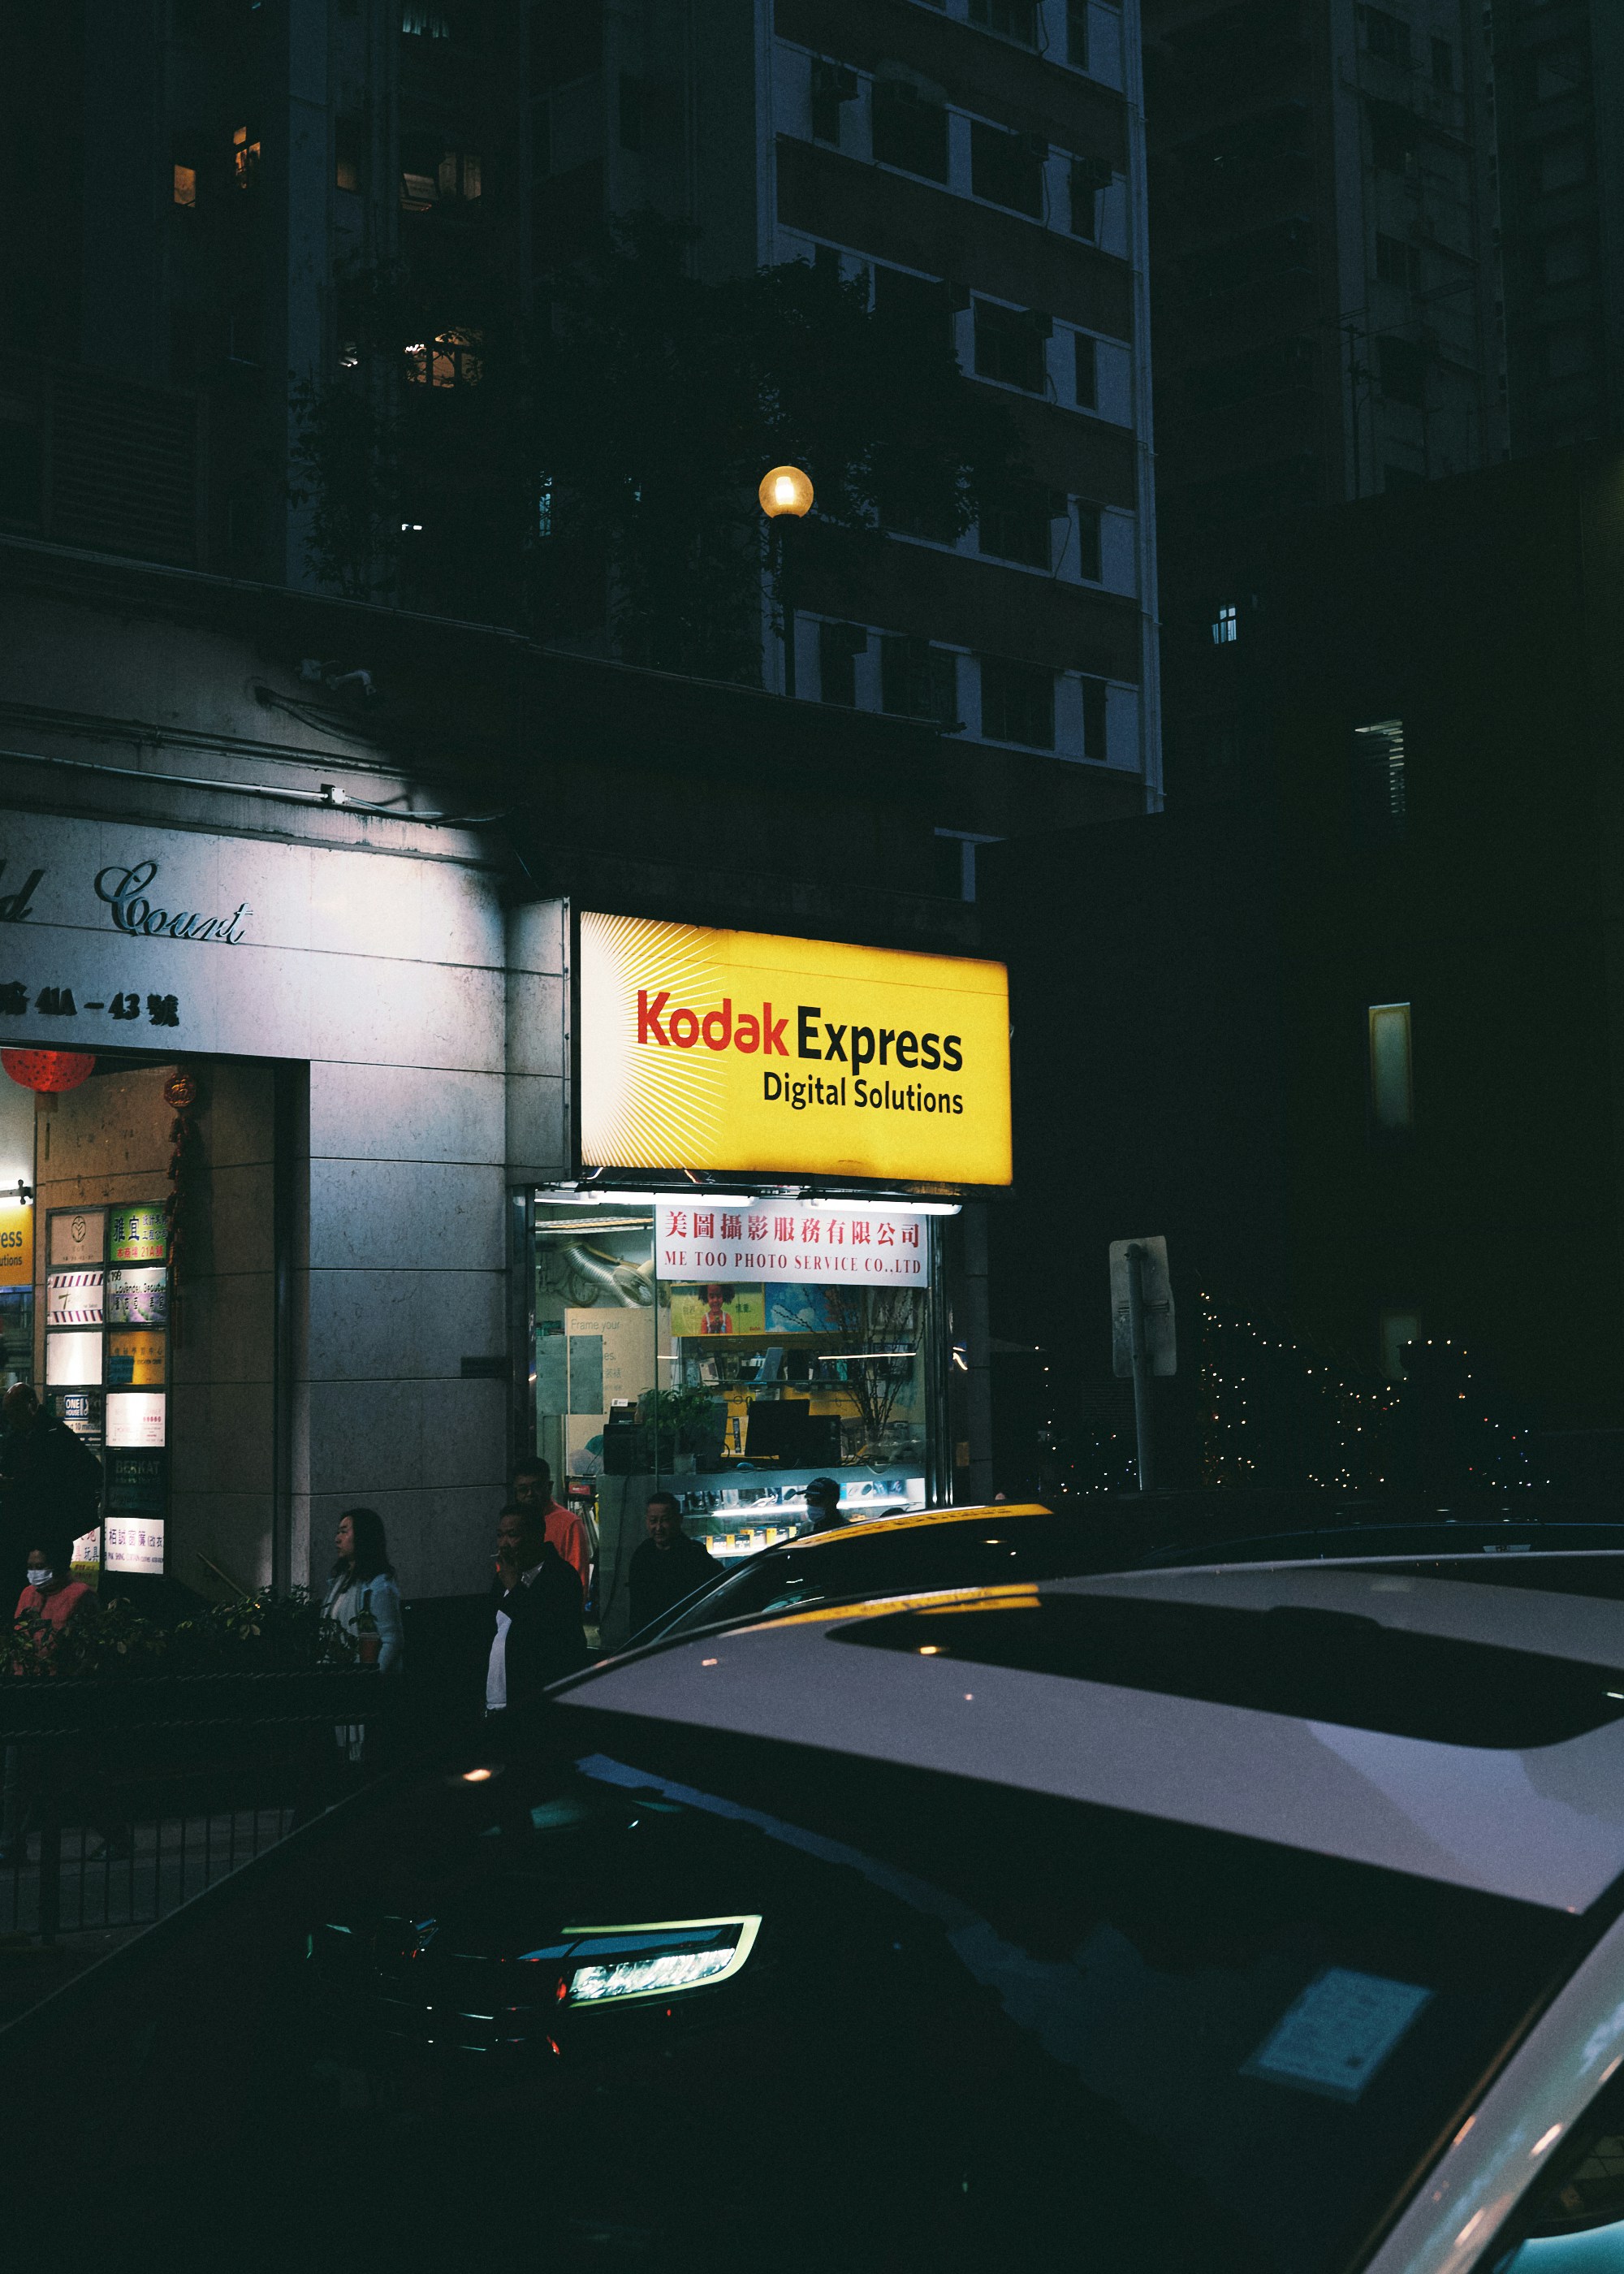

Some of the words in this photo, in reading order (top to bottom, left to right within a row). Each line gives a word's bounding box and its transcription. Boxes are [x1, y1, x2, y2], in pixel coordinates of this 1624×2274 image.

[94, 860, 253, 945] Court
[637, 989, 789, 1057] Kodak
[797, 1005, 964, 1076] Express
[764, 1071, 846, 1110] Digital
[854, 1079, 964, 1115] Solutions
[665, 1210, 920, 1248] 美圖攝影服務有限公司
[665, 1251, 687, 1266] ME
[695, 1252, 728, 1268] TOO
[735, 1253, 788, 1269] PHOTO
[794, 1256, 858, 1273] SERVICE
[571, 1319, 599, 1329] Frame
[602, 1321, 620, 1333] your
[66, 1399, 80, 1409] ONE
